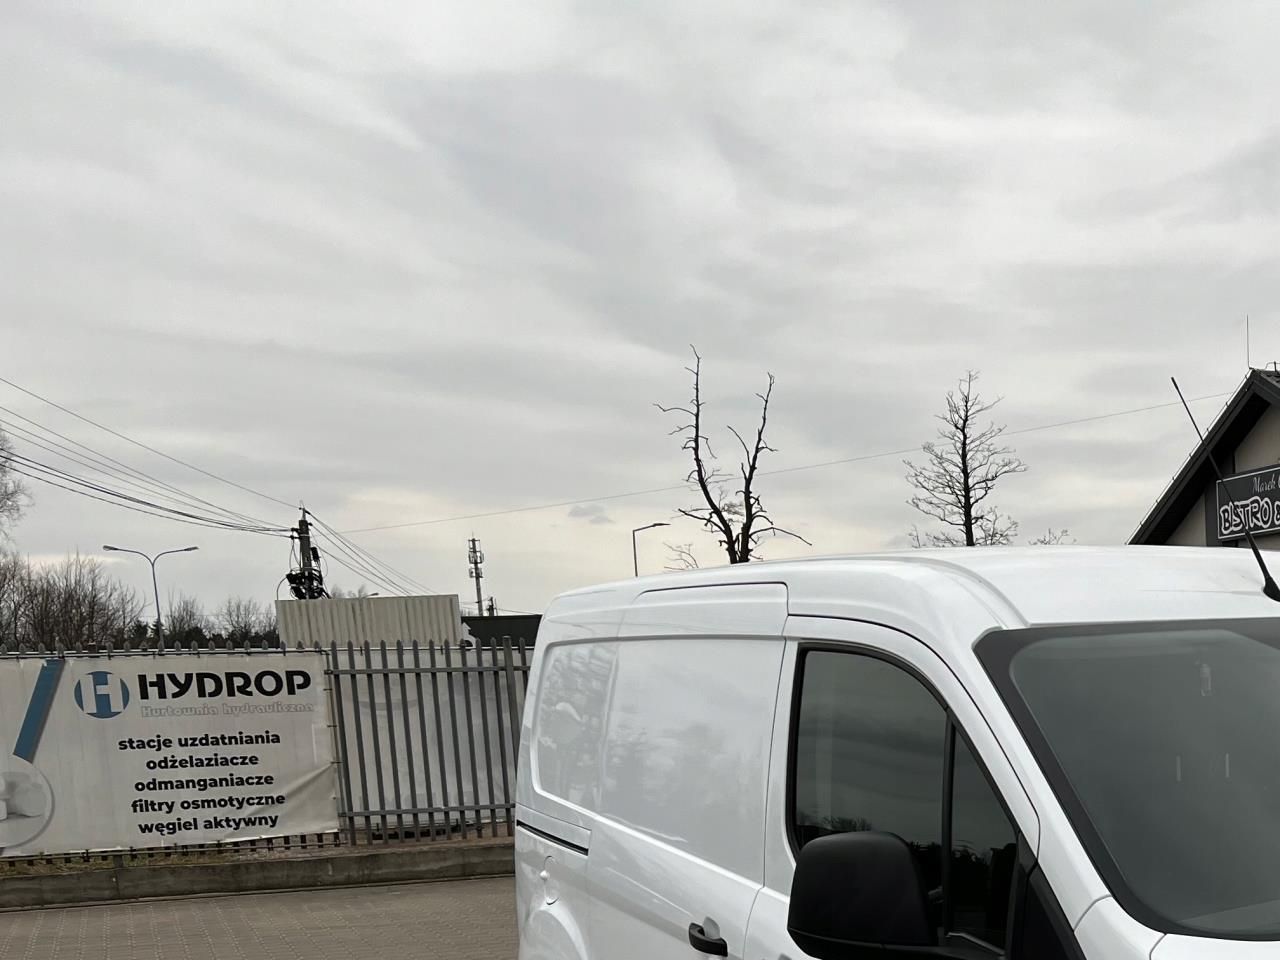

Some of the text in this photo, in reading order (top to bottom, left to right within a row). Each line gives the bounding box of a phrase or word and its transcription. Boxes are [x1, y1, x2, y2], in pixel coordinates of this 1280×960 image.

[1220, 496, 1272, 534] BISTRO
[138, 670, 311, 700] HYDROP
[141, 701, 314, 718] Hurtownia hydrauliczna
[118, 730, 281, 752] stacje uzdatniania
[146, 752, 259, 771] odżelaziacze
[134, 773, 274, 792] odmanganiacze
[131, 793, 286, 814] filtry osmotyczne
[138, 813, 279, 837] węgiel aktywny
